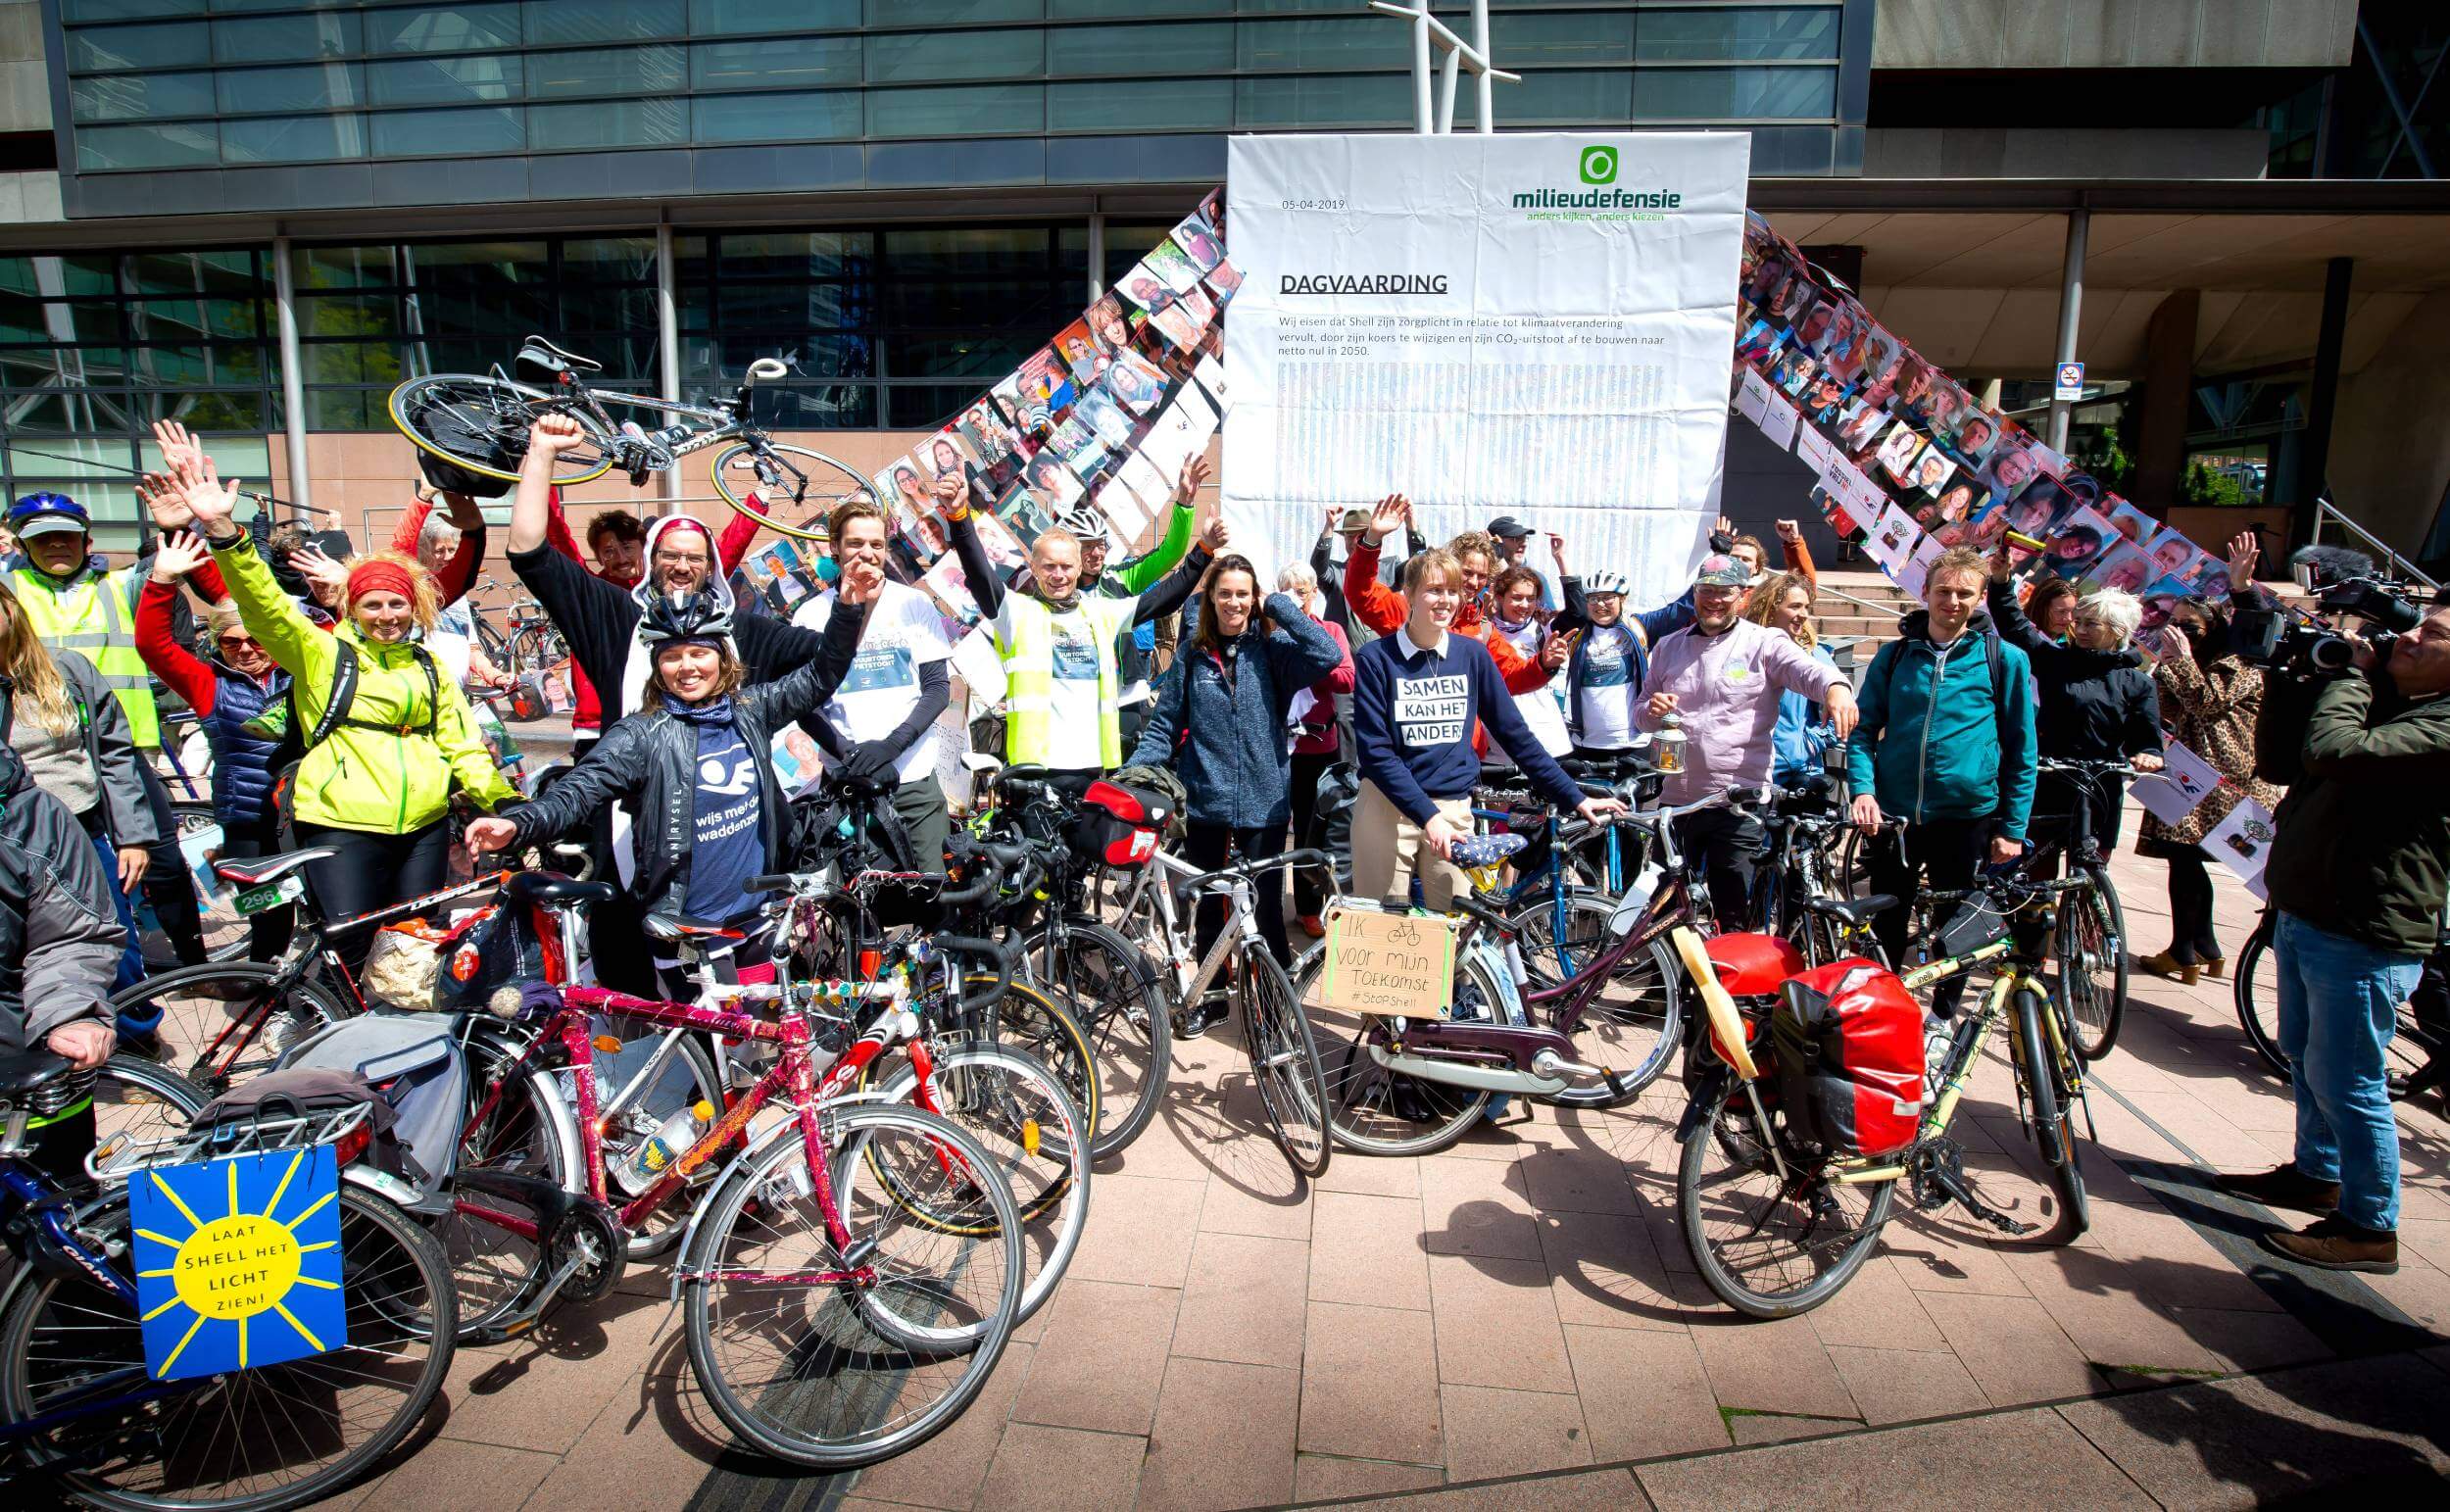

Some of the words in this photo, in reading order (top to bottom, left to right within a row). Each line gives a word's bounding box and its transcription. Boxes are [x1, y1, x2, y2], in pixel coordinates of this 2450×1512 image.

[1282, 199, 1346, 210] 05-04-2019
[1512, 188, 1682, 209] milieudefensie
[1527, 212, 1561, 220] anders
[1562, 211, 1594, 222] kijken,
[1596, 212, 1631, 221] anders
[1632, 212, 1664, 221] kiezen
[1280, 274, 1448, 294] DAGVAARDING
[1279, 317, 1297, 328] Wij
[1299, 317, 1326, 326] eisen
[1329, 317, 1347, 326] dat
[1349, 317, 1374, 326] Shell
[1377, 317, 1396, 328] zijn
[1398, 317, 1450, 329] zorgplicht
[1453, 317, 1463, 327] in
[1466, 317, 1500, 328] relatie
[1502, 317, 1518, 328] tot
[1521, 317, 1624, 330] klimaatverandering
[1278, 332, 1317, 344] vervult,
[1320, 332, 1344, 343] door
[1347, 332, 1365, 344] zijn
[1368, 332, 1396, 343] koers
[1399, 333, 1410, 342] te
[1413, 333, 1455, 345] wijzigen
[1474, 333, 1493, 346] zijn
[1568, 334, 1578, 344] af
[1581, 335, 1592, 344] te
[1595, 334, 1638, 345] bouwen
[1641, 336, 1665, 345] naar
[1278, 346, 1305, 356] netto
[1308, 345, 1325, 356] nul
[1328, 345, 1337, 356] in
[1341, 345, 1370, 357] 2050.
[1403, 678, 1465, 697] SAMEN
[1405, 703, 1437, 717] KAN
[1441, 702, 1466, 716] HET
[1406, 724, 1462, 741] ANDER
[696, 811, 724, 828] wijs
[724, 802, 749, 819] met
[697, 809, 760, 844] waddenze
[242, 890, 275, 911] 296
[1348, 914, 1366, 938] IK
[1641, 912, 1679, 941] UNION
[1386, 951, 1429, 973] mijn
[213, 1225, 256, 1243] LAAT
[184, 1249, 248, 1270] SHELL
[256, 1243, 289, 1258] HET
[62, 1244, 121, 1290] GIANT
[209, 1269, 270, 1292] LICHT
[217, 1293, 266, 1311] ZIEN!
